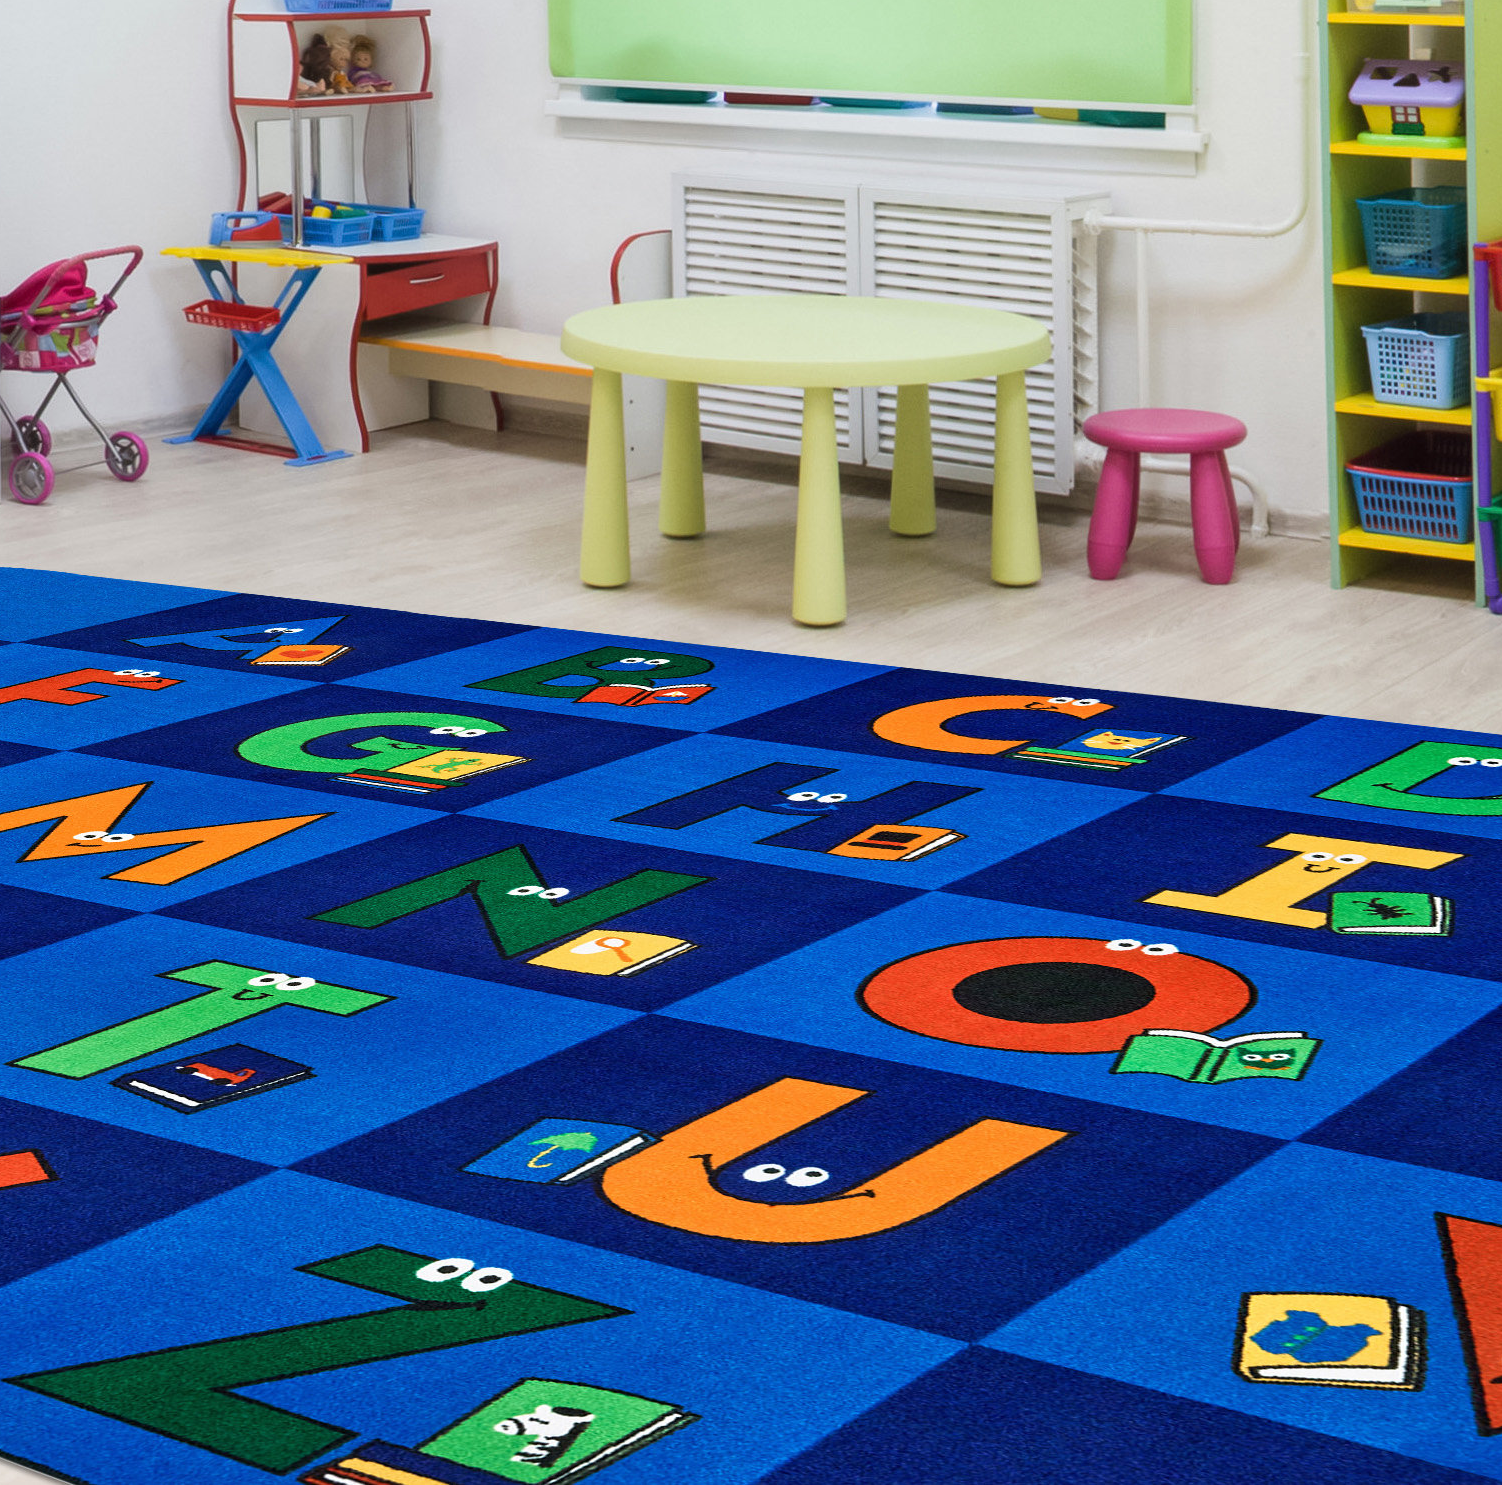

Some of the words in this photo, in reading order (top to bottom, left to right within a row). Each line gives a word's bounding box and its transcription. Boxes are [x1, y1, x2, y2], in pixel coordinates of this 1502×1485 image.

[464, 645, 716, 699] B
[871, 693, 1116, 757] C
[234, 711, 510, 774] G
[609, 761, 985, 854] H
[306, 843, 716, 961] N
[1140, 830, 1467, 931] I
[5, 958, 398, 1081] T
[854, 935, 1259, 1055] O
[599, 1074, 1084, 1246] U
[1, 1242, 637, 1477] Z
